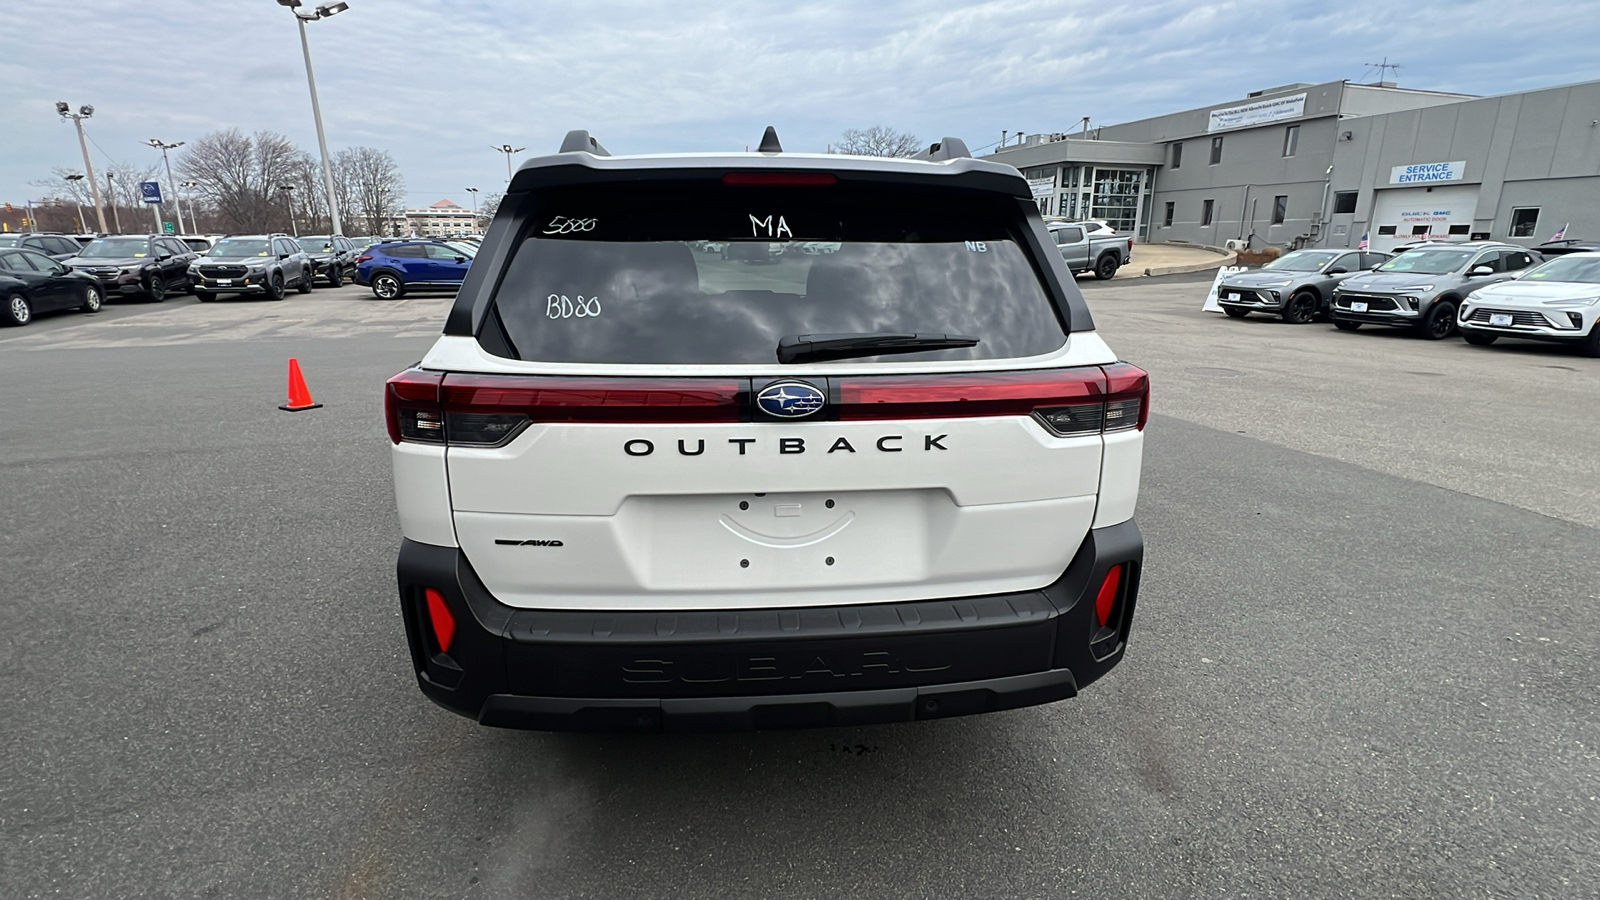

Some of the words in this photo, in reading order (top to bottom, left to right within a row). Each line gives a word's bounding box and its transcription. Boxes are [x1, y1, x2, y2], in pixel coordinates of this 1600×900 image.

[1399, 171, 1453, 182] ENTRANCE
[1406, 163, 1449, 174] SERVICE
[748, 213, 793, 238] MA
[965, 240, 987, 252] NB
[546, 294, 601, 319] BD80
[623, 434, 948, 456] OUTBACK
